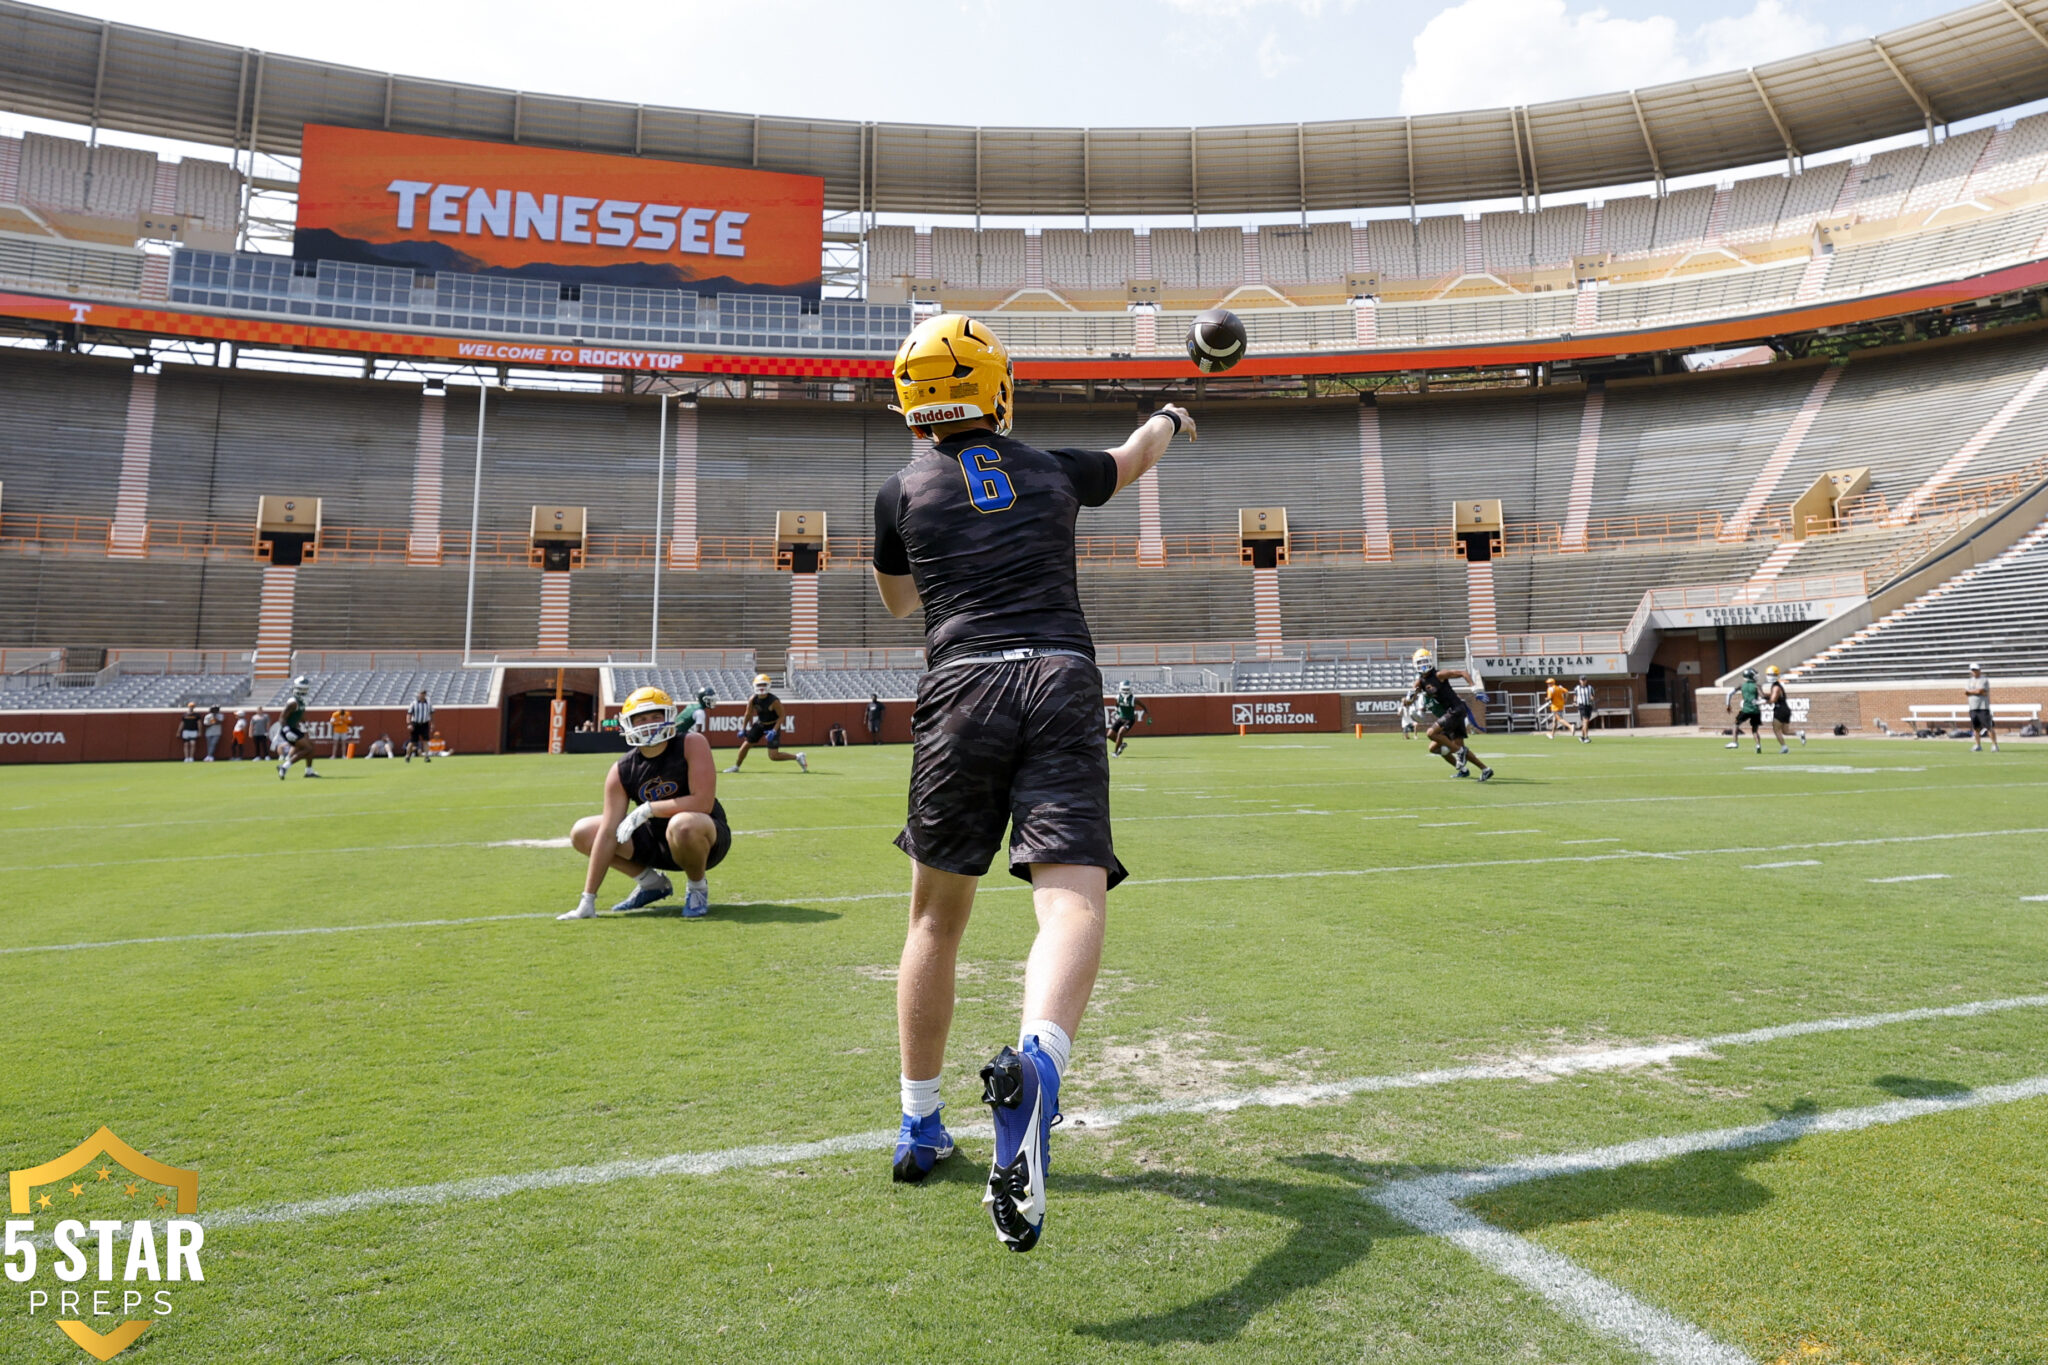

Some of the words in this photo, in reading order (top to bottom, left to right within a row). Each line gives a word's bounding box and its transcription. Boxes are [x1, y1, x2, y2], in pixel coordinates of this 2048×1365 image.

[386, 179, 750, 257] TENNESSEE
[69, 303, 92, 322] T
[458, 343, 546, 361] WELCOME
[551, 350, 573, 361] TO
[579, 349, 644, 367] ROCKY
[647, 353, 683, 369] TOP
[913, 406, 965, 423] Riddell
[957, 444, 1017, 514] 6
[1706, 607, 1759, 617] STOKELY
[1768, 603, 1812, 613] FAMILY
[1714, 616, 1752, 627] MEDIA
[1761, 613, 1807, 624] CENTER
[1486, 658, 1522, 667] WOLF
[1538, 656, 1594, 666] KAPLAN
[1511, 666, 1564, 675] CENTER
[1255, 703, 1291, 713] FIRST
[551, 701, 564, 754] VOLS
[0, 731, 66, 745] TOYOTA
